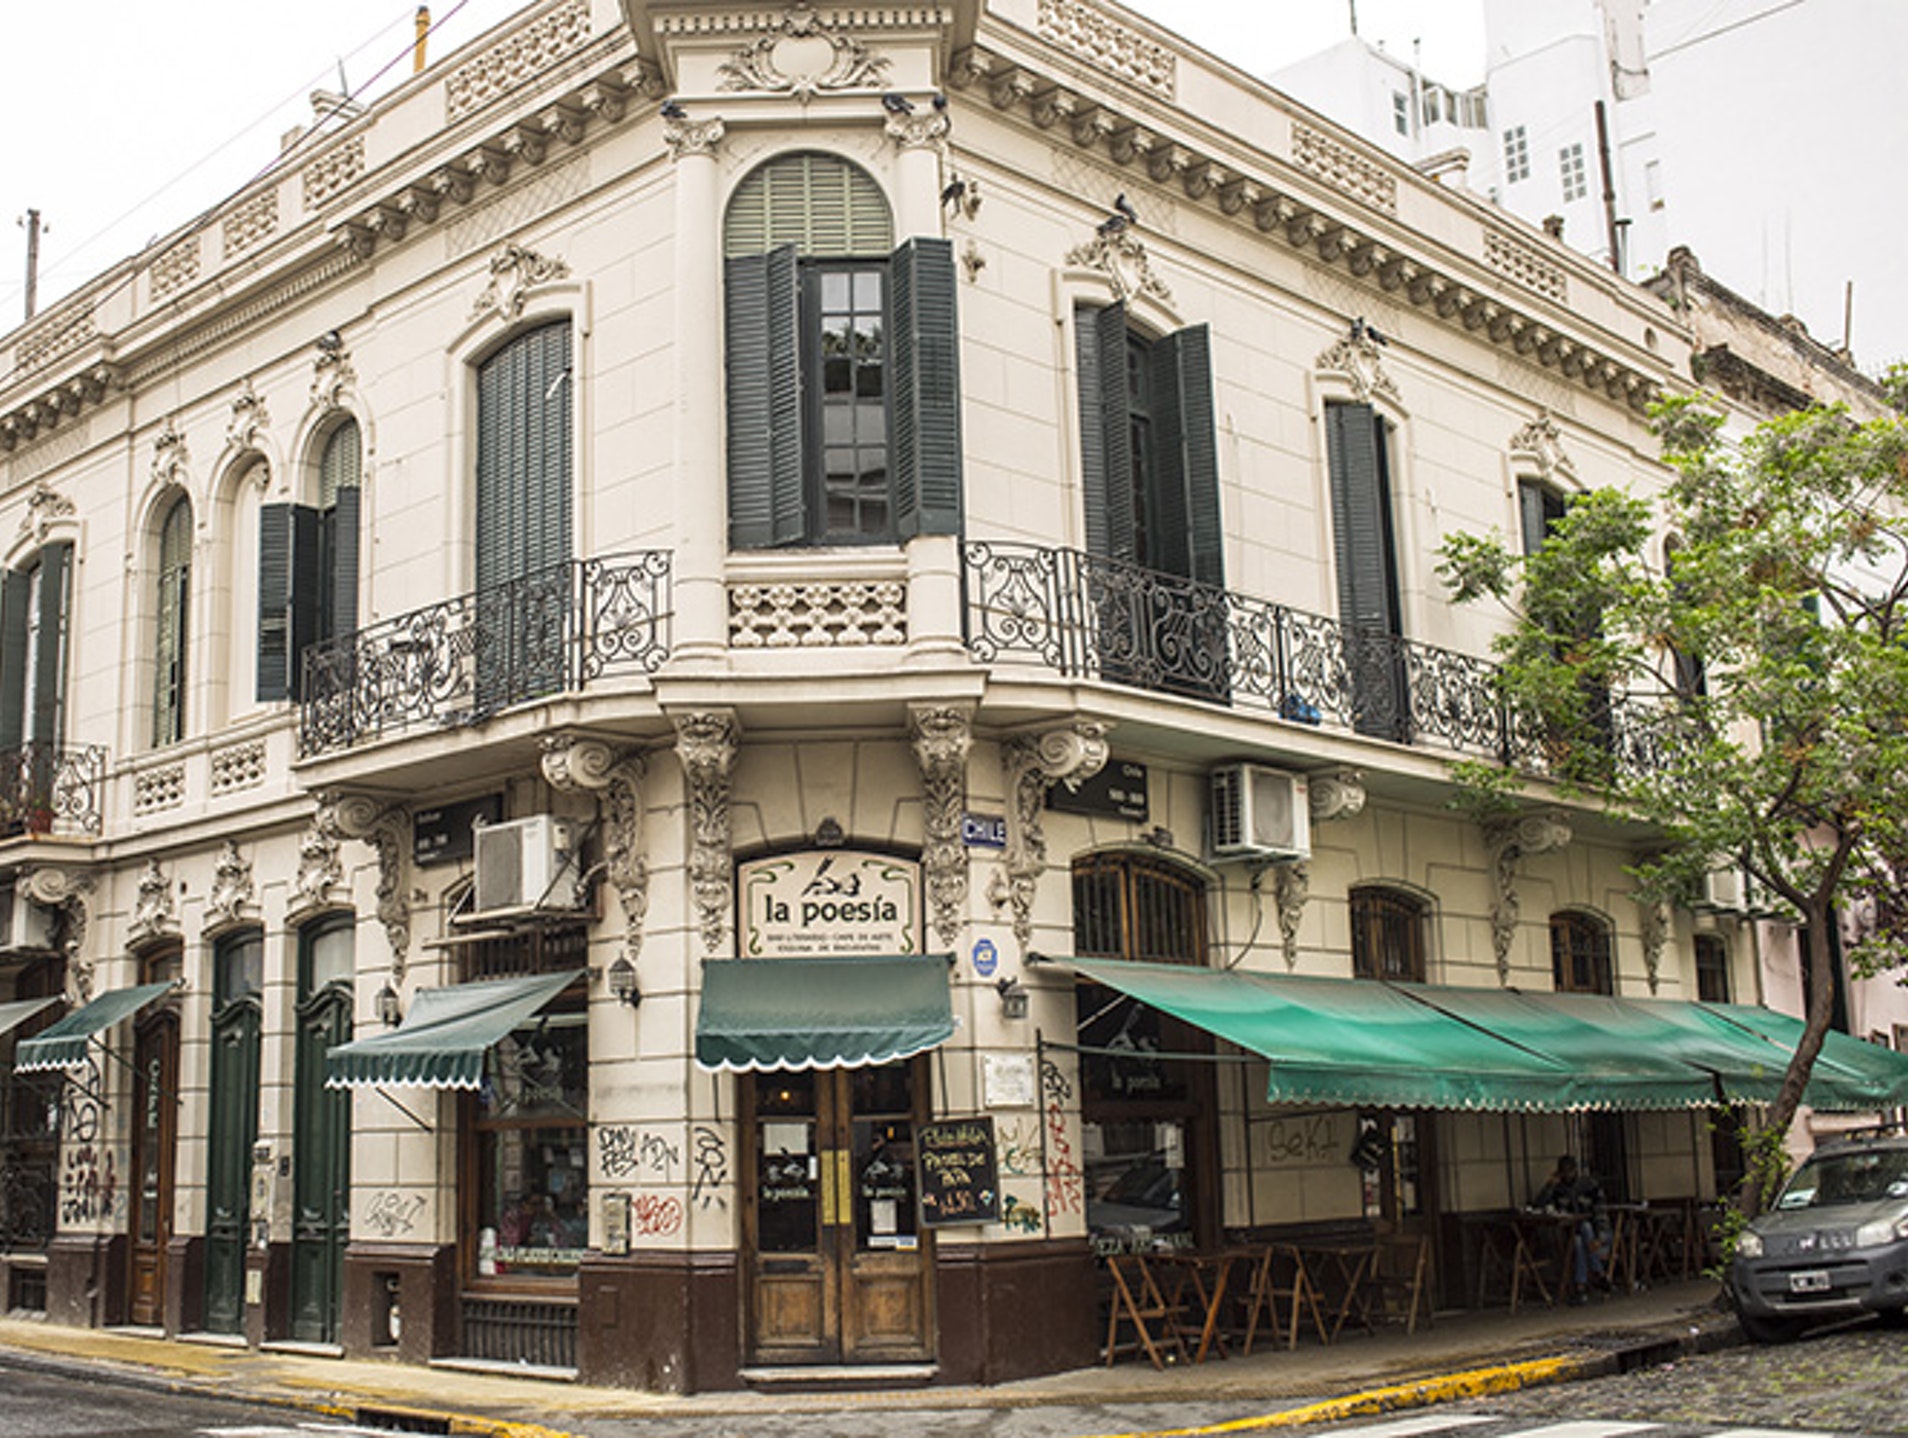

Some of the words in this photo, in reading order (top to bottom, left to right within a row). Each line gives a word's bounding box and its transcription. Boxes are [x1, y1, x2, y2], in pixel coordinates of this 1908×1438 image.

[963, 818, 1005, 842] CHILE
[765, 894, 790, 922] la
[801, 894, 897, 927] poesía
